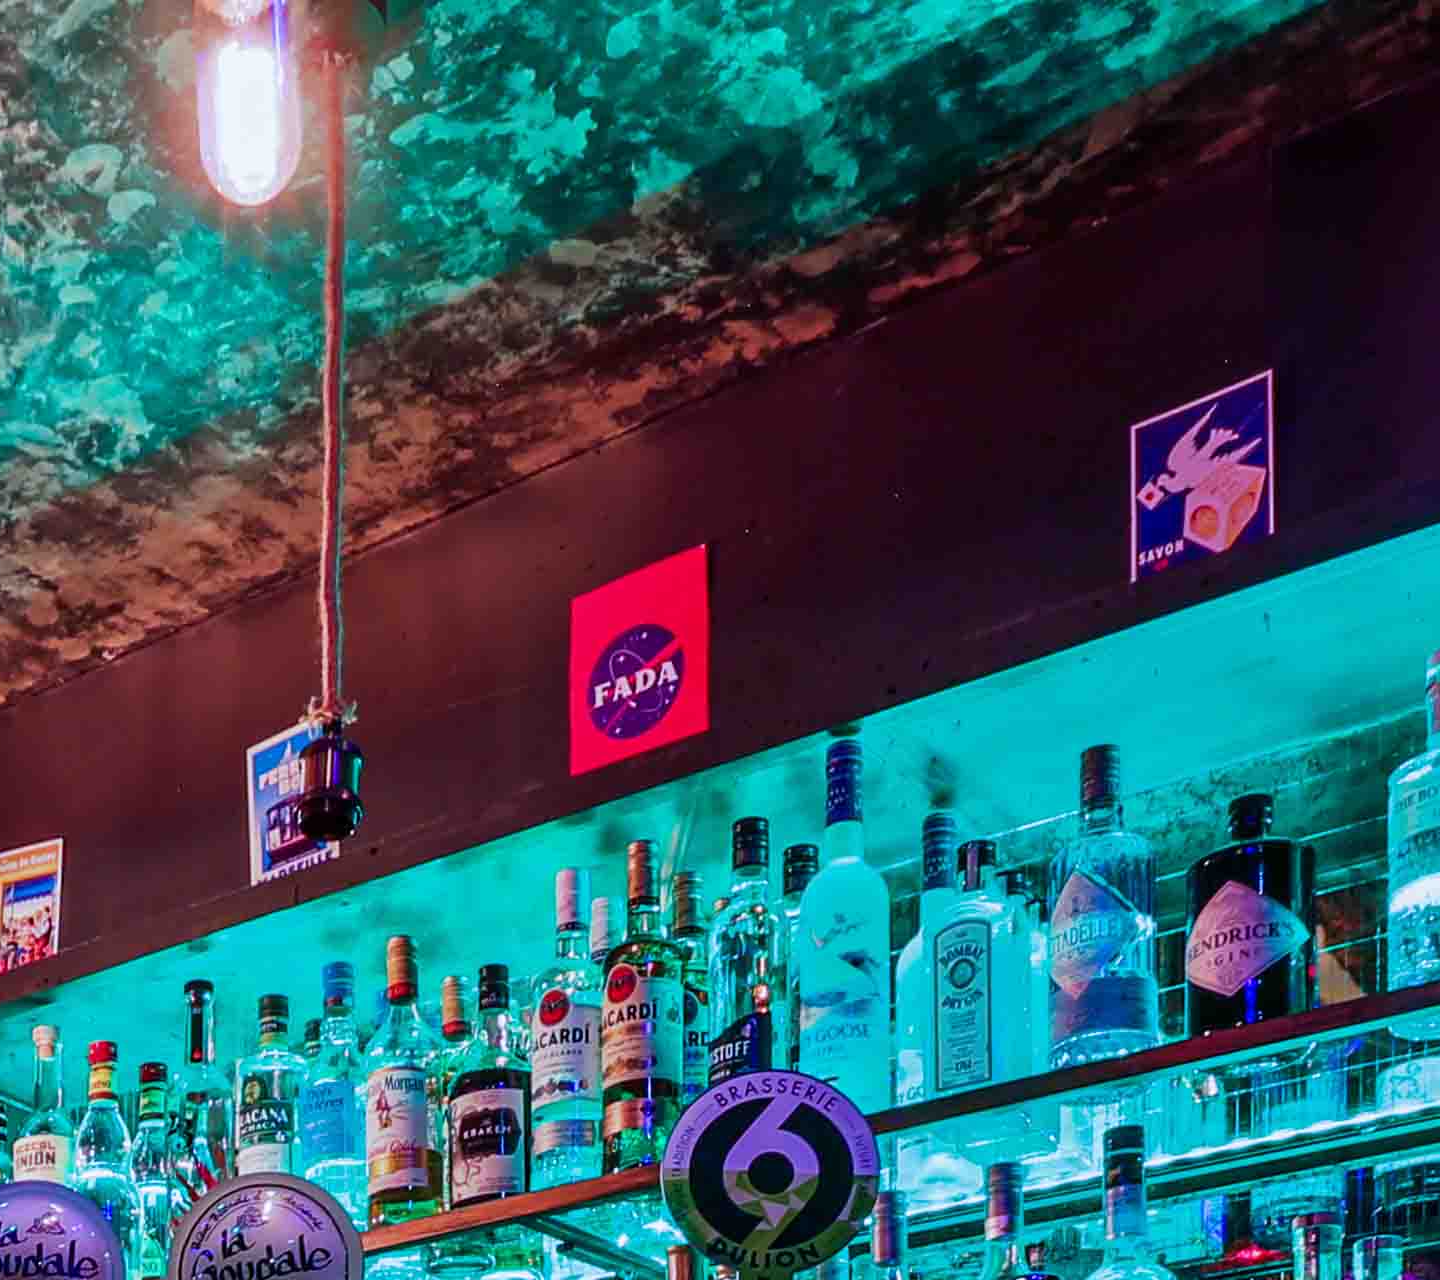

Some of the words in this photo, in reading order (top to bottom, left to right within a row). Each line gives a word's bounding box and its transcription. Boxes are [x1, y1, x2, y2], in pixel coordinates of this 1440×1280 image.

[1138, 540, 1184, 566] SAVON
[593, 661, 679, 709] FADA
[938, 943, 985, 967] BOMBAY
[1214, 948, 1251, 968] GIN
[816, 1023, 868, 1041] GOOSE
[714, 1077, 837, 1112] BRASSERIE
[463, 1126, 511, 1139] KRAKEN
